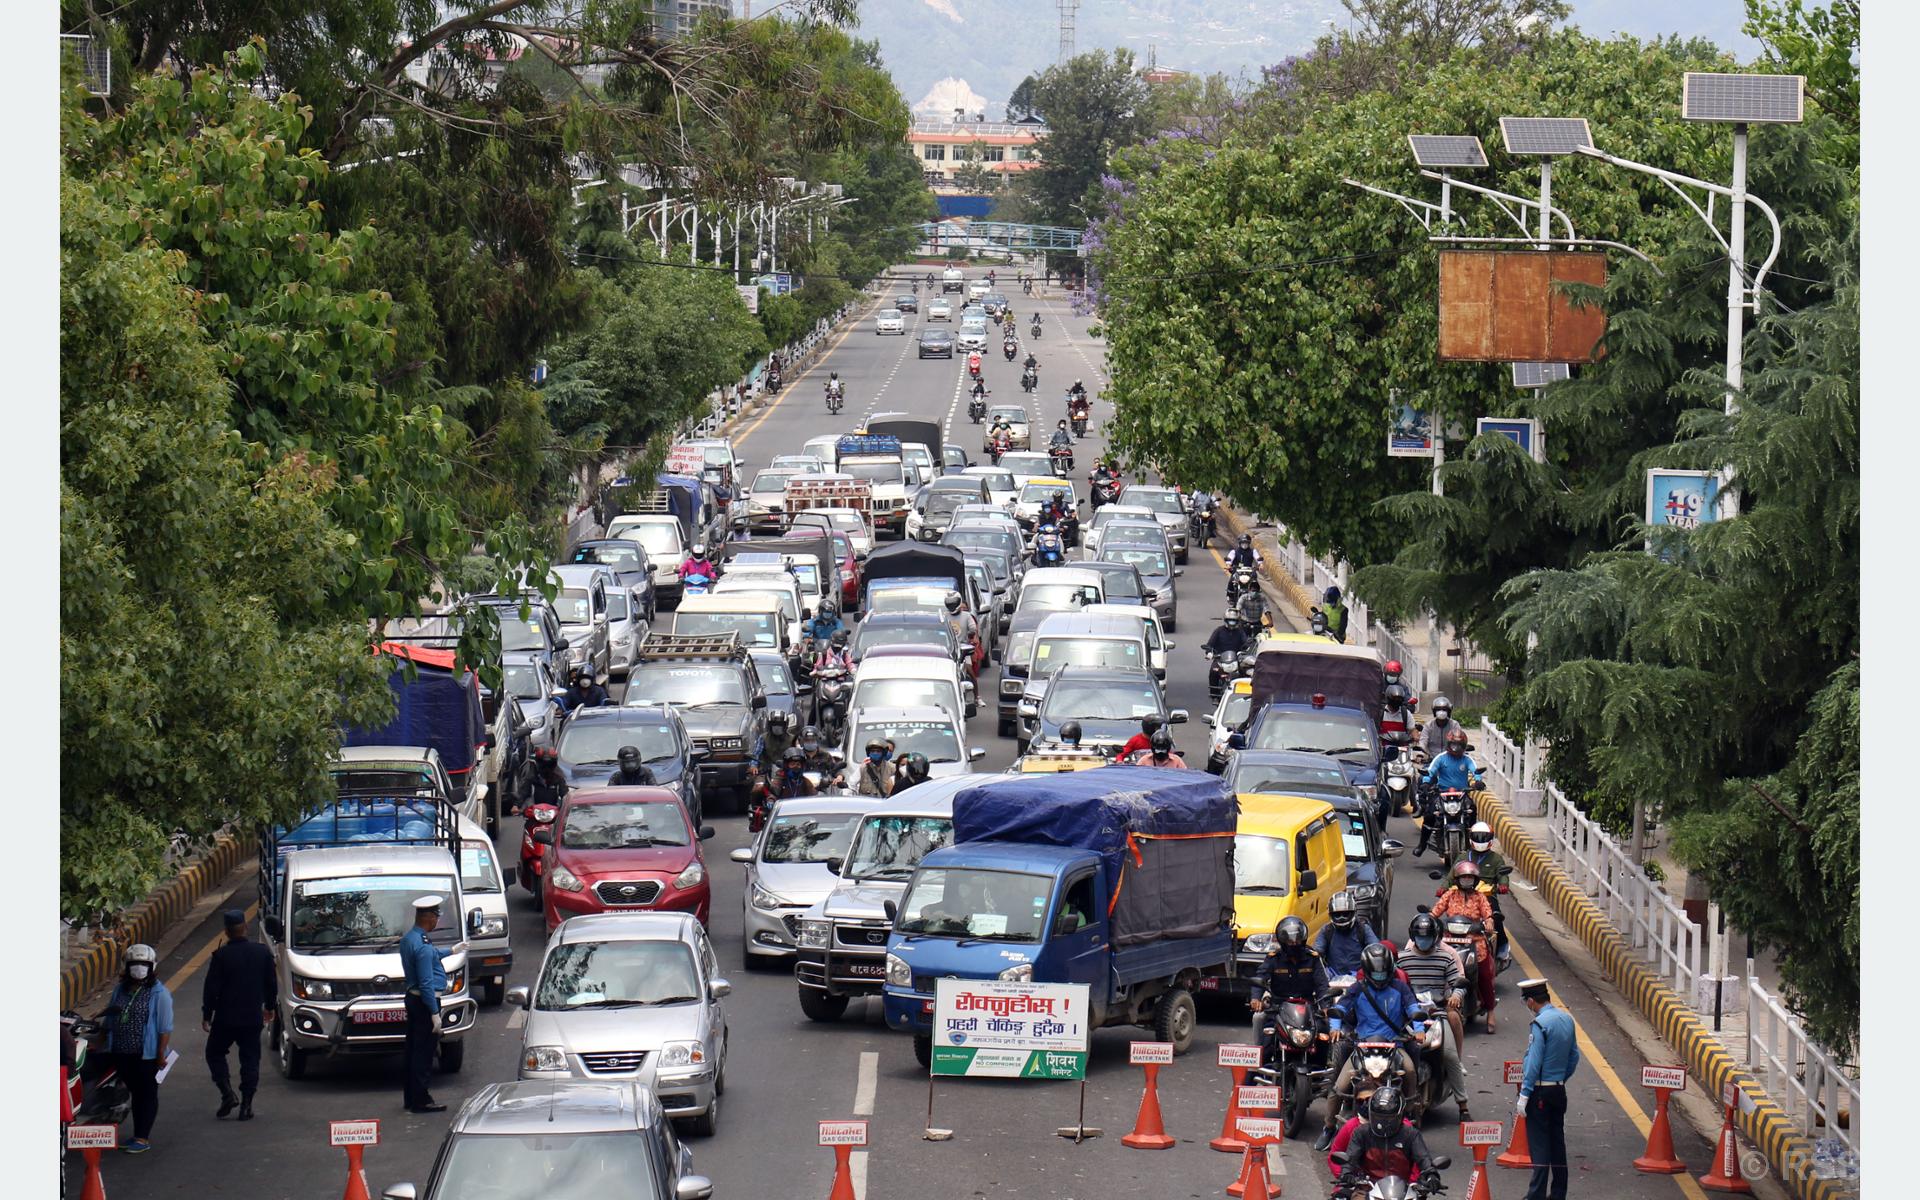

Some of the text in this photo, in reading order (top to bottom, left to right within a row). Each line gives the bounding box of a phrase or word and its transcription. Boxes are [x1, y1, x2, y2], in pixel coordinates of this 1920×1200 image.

[876, 722, 936, 730] SUZUKI
[955, 991, 1057, 1018] रोक्नुहोस्
[946, 1017, 978, 1032] प्रहरी
[1045, 1051, 1078, 1071] शिवम्
